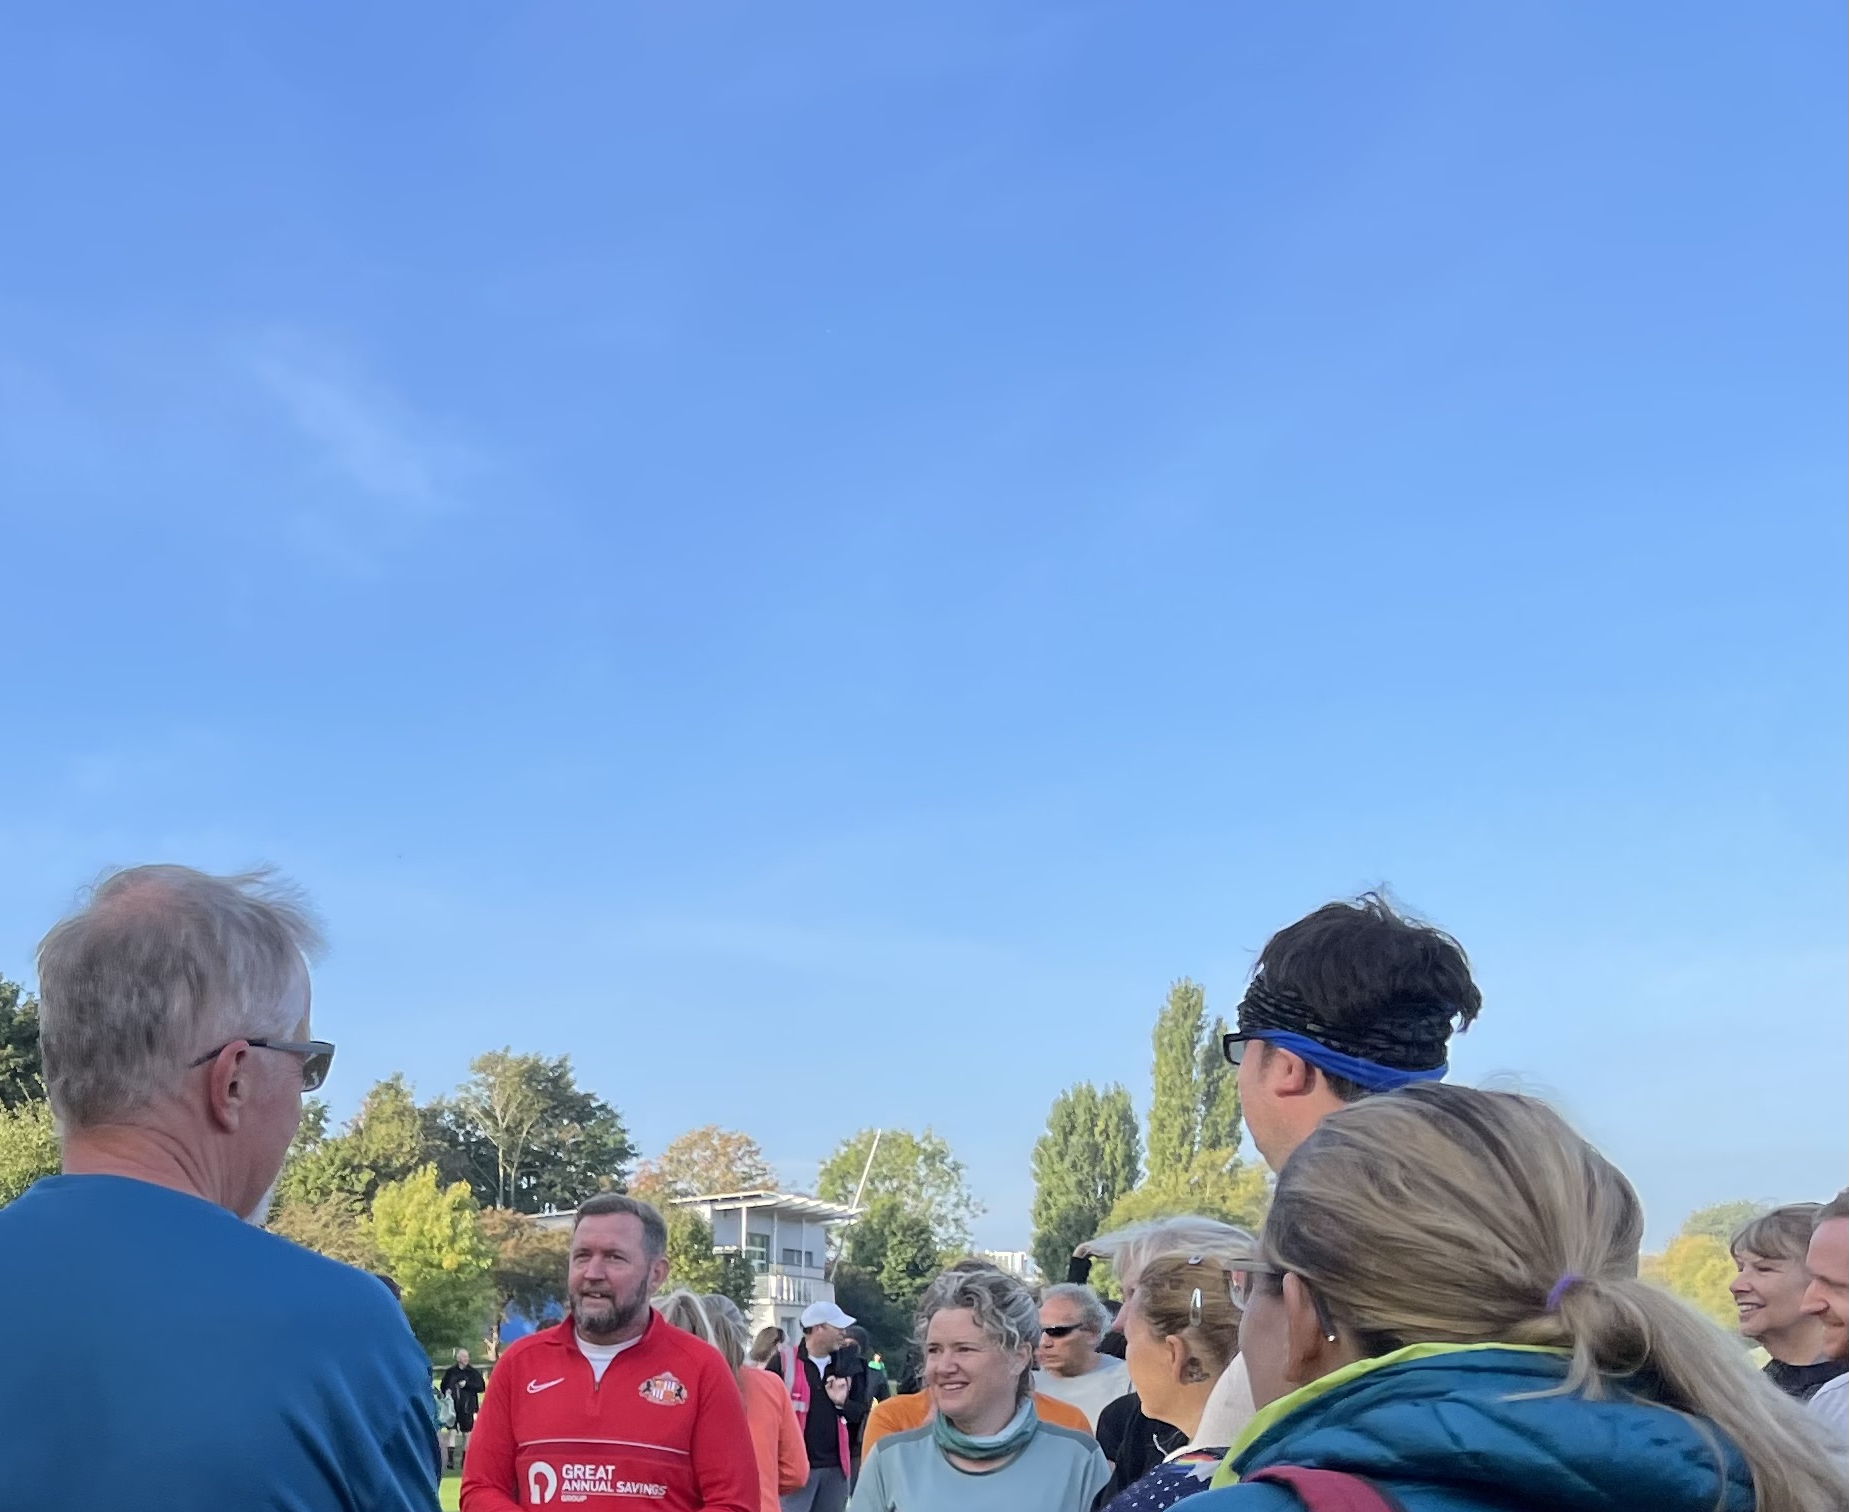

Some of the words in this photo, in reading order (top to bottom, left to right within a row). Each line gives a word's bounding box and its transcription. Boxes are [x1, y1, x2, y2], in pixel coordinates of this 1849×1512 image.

[561, 1464, 616, 1480] GREAT
[561, 1479, 615, 1493] ANNUAL
[616, 1481, 668, 1496] SAVINGS
